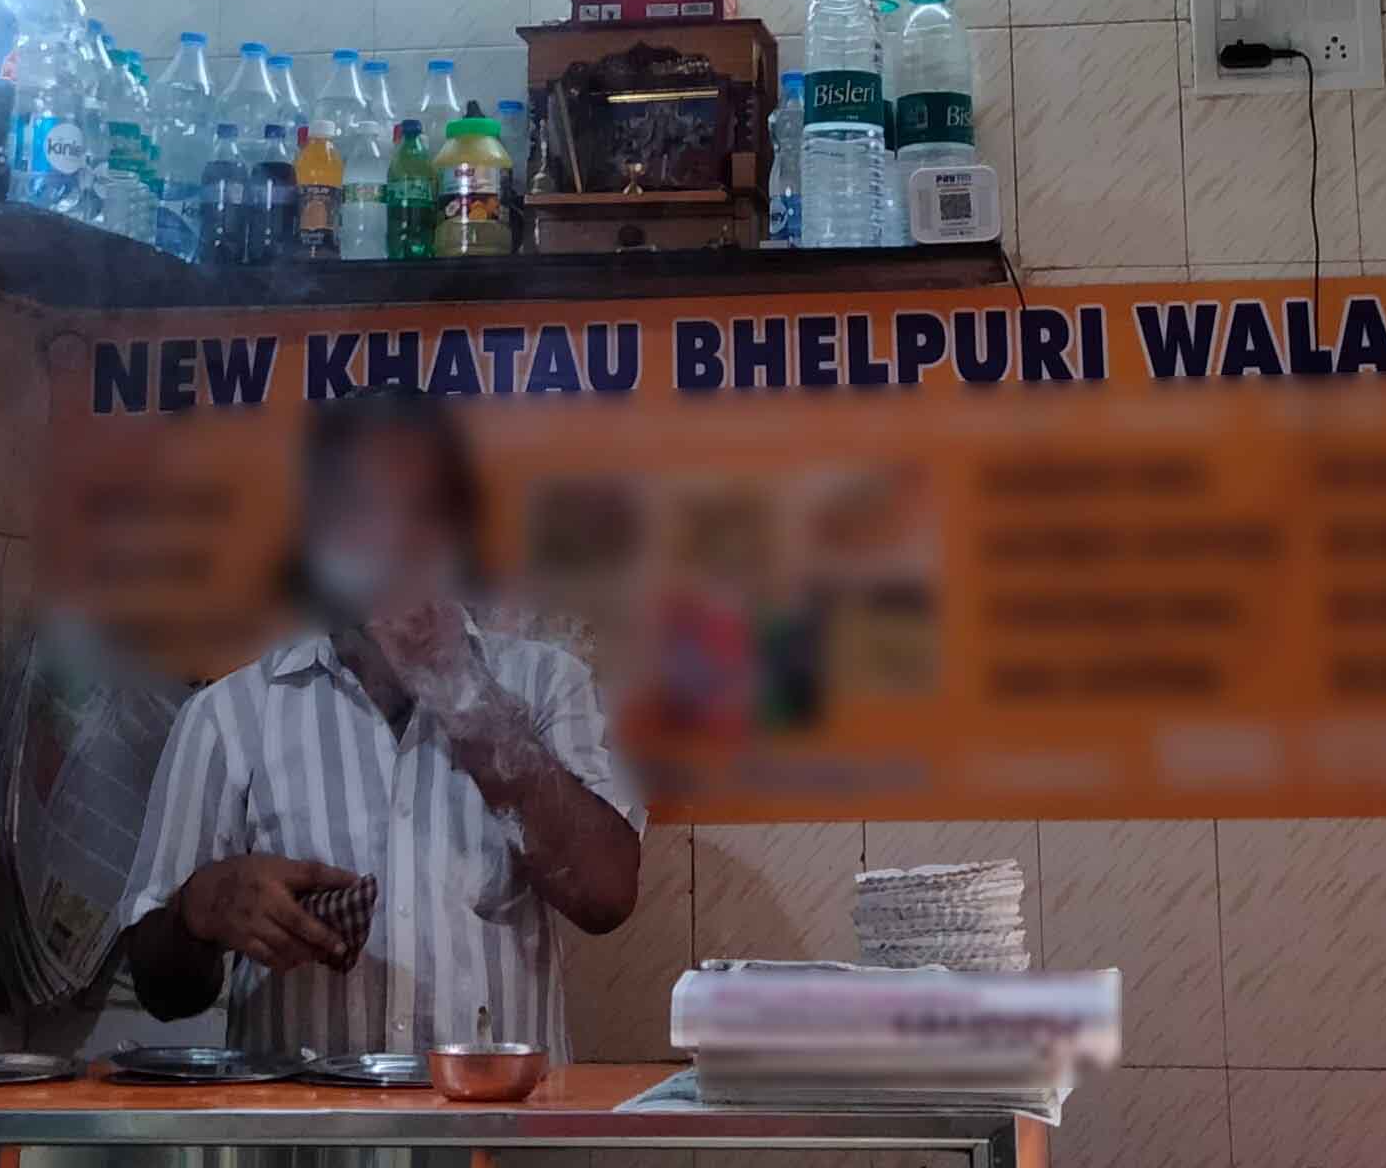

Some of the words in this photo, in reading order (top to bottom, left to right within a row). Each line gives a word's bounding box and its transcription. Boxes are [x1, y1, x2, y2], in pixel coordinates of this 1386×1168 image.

[813, 80, 876, 108] Bisleri
[93, 335, 278, 414] NEW
[304, 320, 643, 400] KHATAU
[674, 304, 1108, 389] BHELPURI
